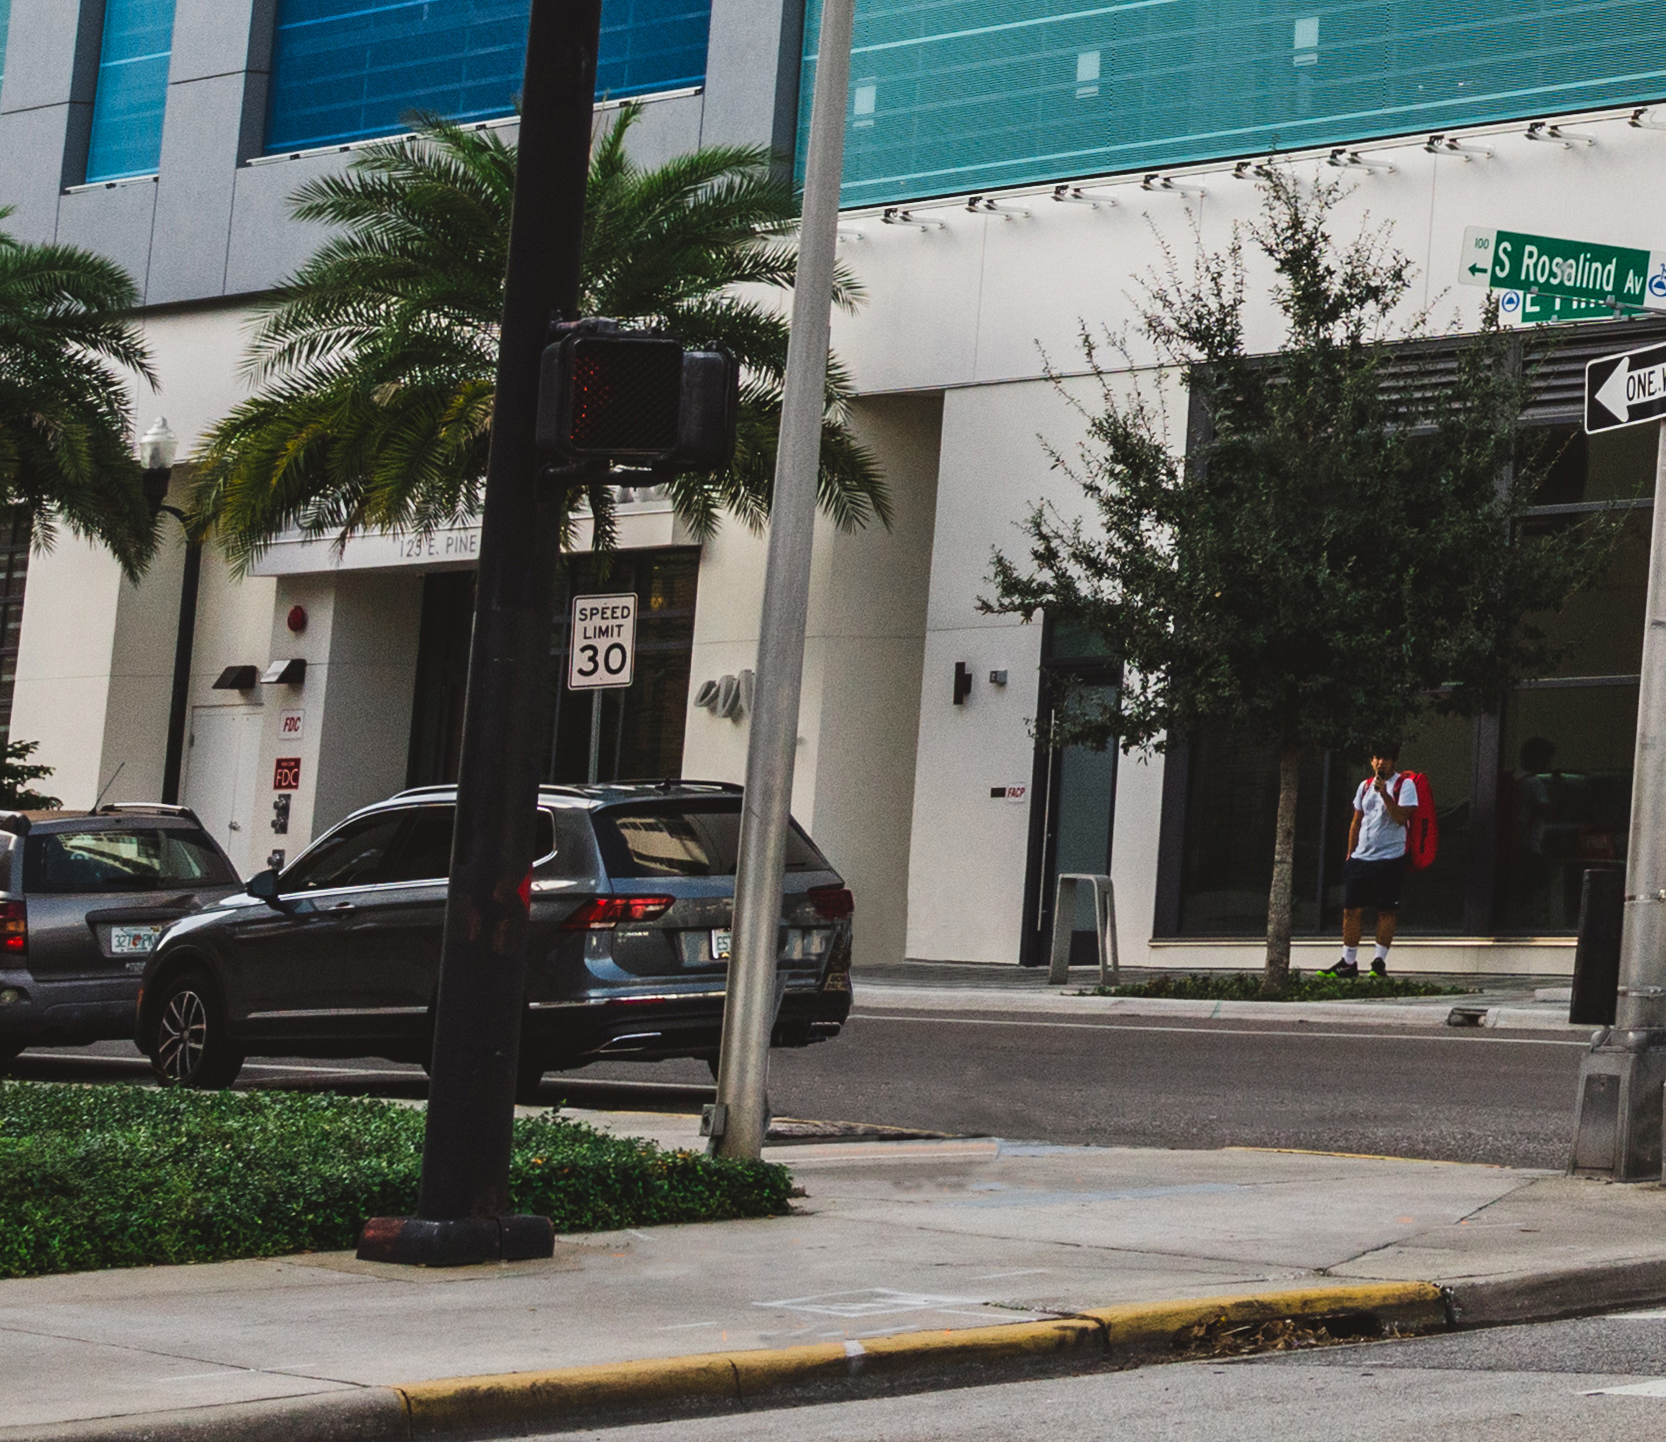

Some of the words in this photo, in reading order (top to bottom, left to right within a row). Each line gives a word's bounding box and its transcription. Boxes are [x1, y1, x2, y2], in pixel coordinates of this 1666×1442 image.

[1474, 238, 1490, 250] 100
[1495, 241, 1512, 278] S
[1520, 245, 1617, 292] Rosalind
[1623, 269, 1643, 295] Av
[1626, 370, 1656, 401] ONE
[445, 534, 477, 553] PINE
[578, 605, 631, 621] SPEED
[583, 624, 624, 640] LIMIT
[577, 642, 627, 677] 30
[283, 717, 302, 732] FDC
[276, 768, 299, 786] FDC
